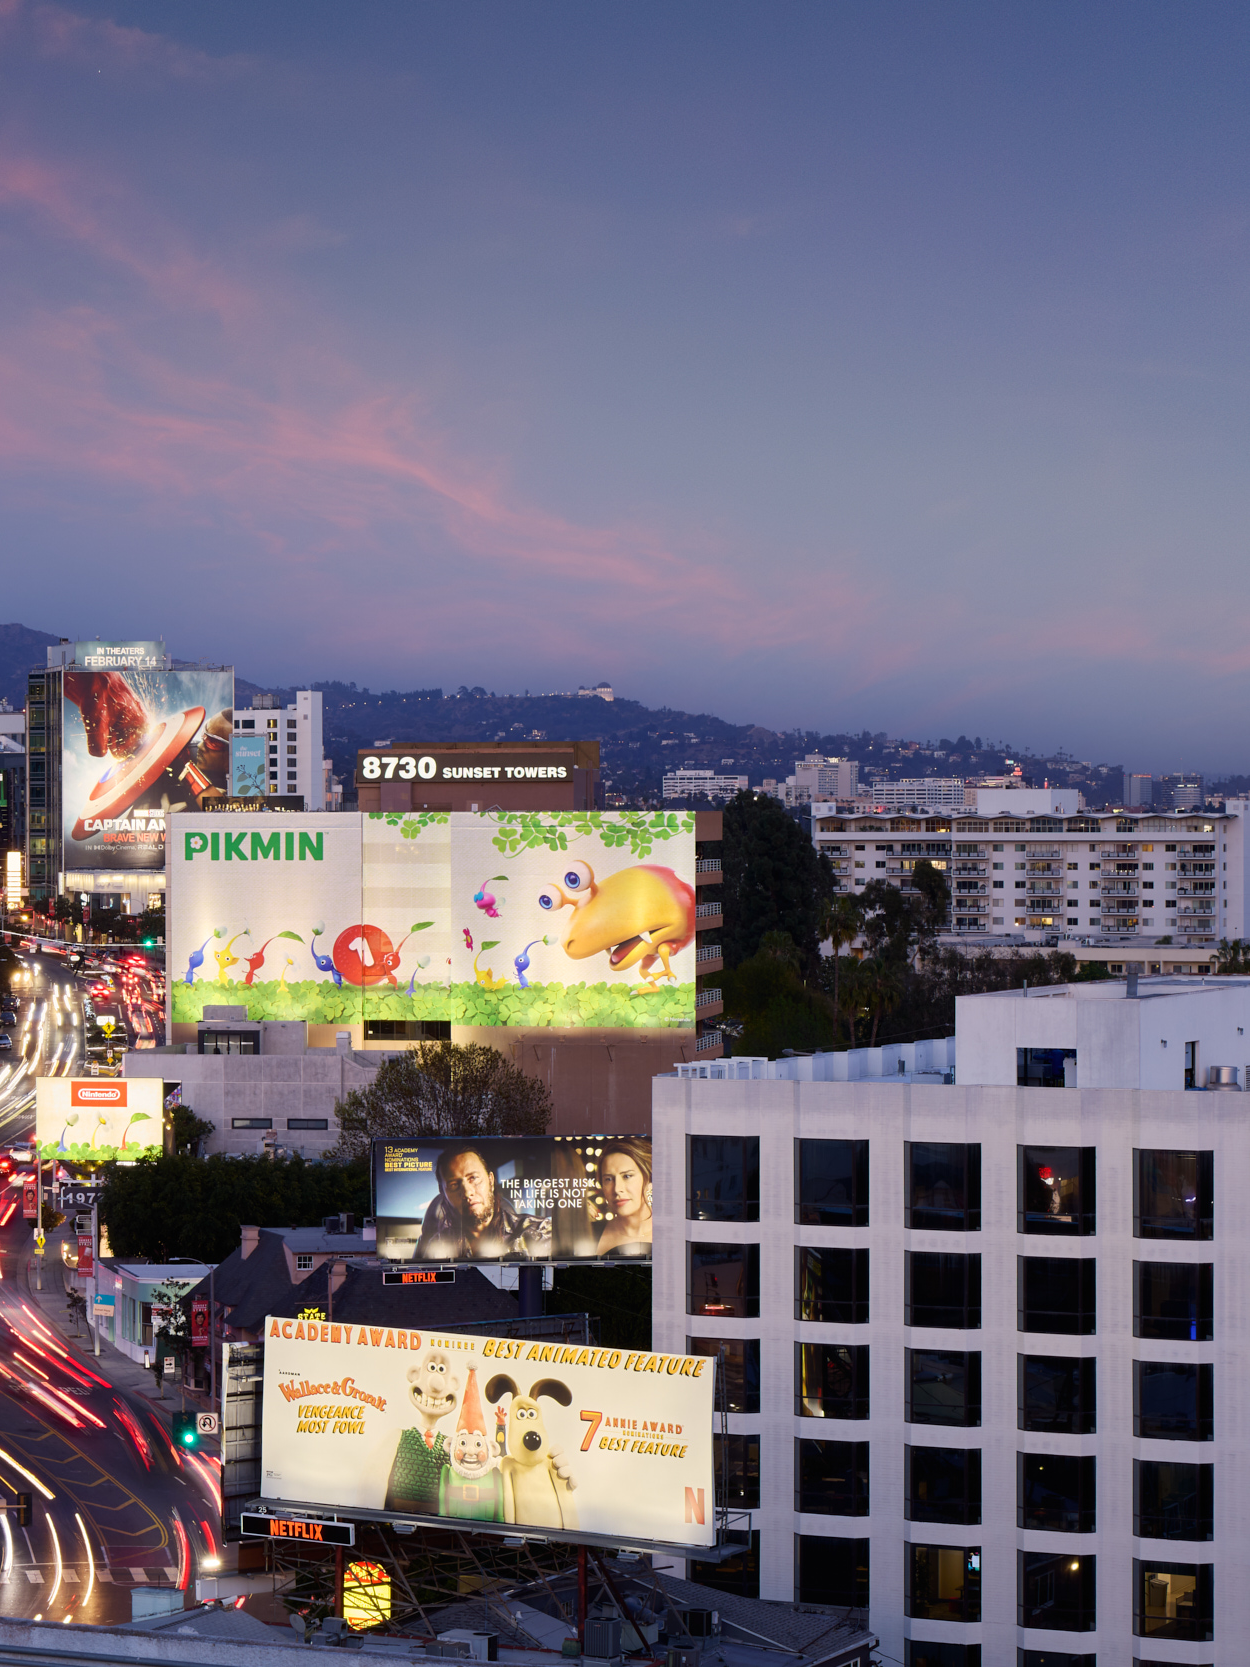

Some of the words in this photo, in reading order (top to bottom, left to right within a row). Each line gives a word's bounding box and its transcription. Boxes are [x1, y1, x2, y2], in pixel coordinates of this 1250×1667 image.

[84, 656, 142, 666] FEBRUARY
[145, 656, 156, 666] 14
[362, 756, 437, 780] 8730
[442, 766, 502, 778] SUNSET
[504, 765, 568, 778] TOWERS
[84, 818, 146, 831] CAPTAIN
[103, 832, 136, 842] BRAVE
[137, 832, 160, 842] NEW
[184, 832, 324, 860] PIKMIN
[350, 936, 375, 968] 1
[500, 1179, 522, 1188] THE
[523, 1178, 569, 1188] BIGGEST
[572, 1178, 595, 1188] RISK
[510, 1189, 523, 1198] IN
[526, 1189, 546, 1198] LIFE
[549, 1189, 560, 1198] IS
[562, 1189, 586, 1198] NOT
[514, 1199, 555, 1209] TAKING
[558, 1199, 582, 1208] ONE
[402, 1272, 436, 1283] NETFLIX
[297, 1312, 326, 1320] STATE
[269, 1318, 352, 1344] ACADEMY
[357, 1326, 421, 1350] AWARD
[430, 1337, 475, 1351] NOMINEE
[483, 1339, 524, 1360] BEST
[528, 1344, 620, 1370] ANIMATED
[626, 1352, 707, 1378] FEATURE
[298, 1405, 366, 1419] VENGEANCE
[297, 1420, 328, 1434] MOST
[332, 1421, 366, 1434] FOWL
[580, 1410, 603, 1452] 7
[605, 1417, 638, 1430] ANNIE
[622, 1430, 664, 1440] NOMINATIONS
[599, 1436, 628, 1452] BEST
[631, 1440, 689, 1458] FEATURE
[685, 1486, 705, 1524] N
[270, 1519, 323, 1541] NETFLIX
